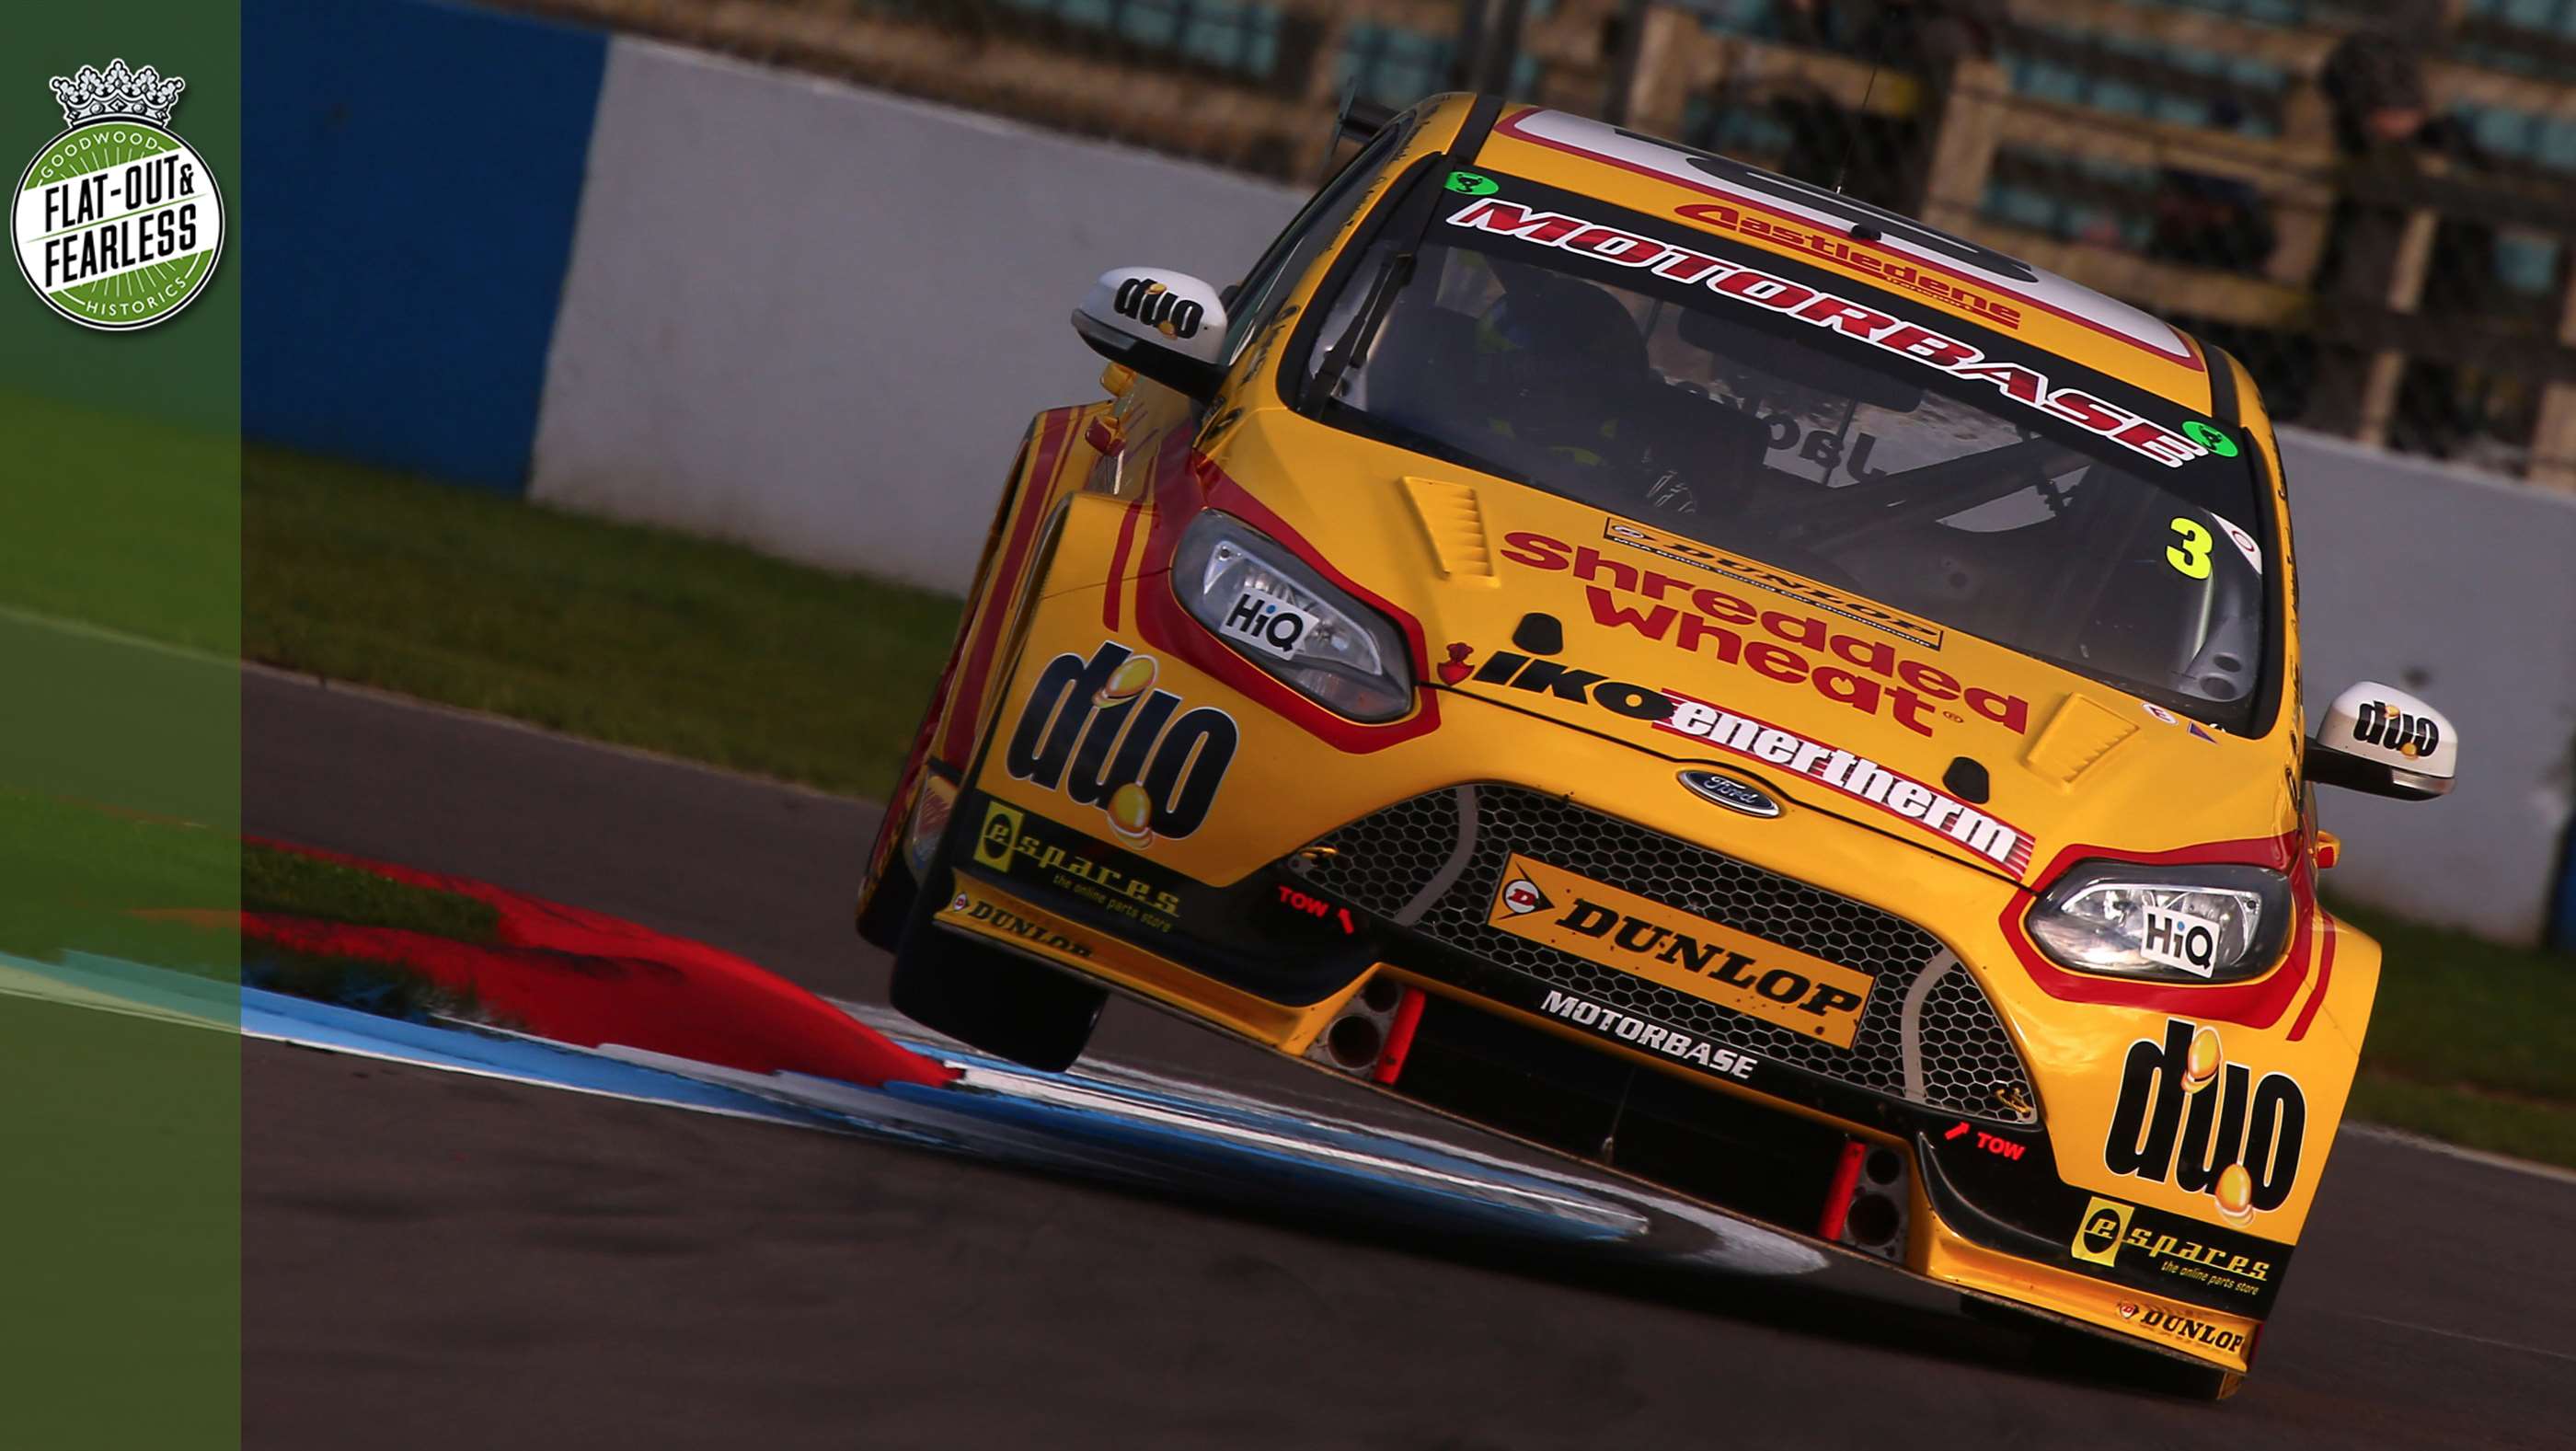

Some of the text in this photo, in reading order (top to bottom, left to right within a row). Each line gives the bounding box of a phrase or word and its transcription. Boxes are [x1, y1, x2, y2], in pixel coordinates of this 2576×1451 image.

[1114, 278, 1204, 340] duo
[1445, 198, 2209, 468] MOTORBASE
[2166, 517, 2214, 580] 3
[1663, 543, 1938, 636] DUNLOP
[1225, 593, 1304, 652] HiQ
[1501, 531, 2029, 735] Shredded
[1007, 640, 1238, 848] duo
[2353, 700, 2440, 758] duo
[1672, 699, 2018, 863] enertherm
[1704, 776, 1759, 803] Ford
[969, 900, 1095, 957] DUNLOP
[1279, 886, 1328, 918] TOW
[1555, 897, 1862, 1018] DUNLOP
[2145, 914, 2214, 968] HiQ
[1540, 990, 1759, 1079] MOTORBASE
[1977, 1132, 2025, 1161] TOW
[2104, 1017, 2307, 1226] duo
[2161, 1260, 2179, 1274] the
[2208, 1275, 2235, 1289] parts
[2141, 1309, 2245, 1353] DUNLOP
